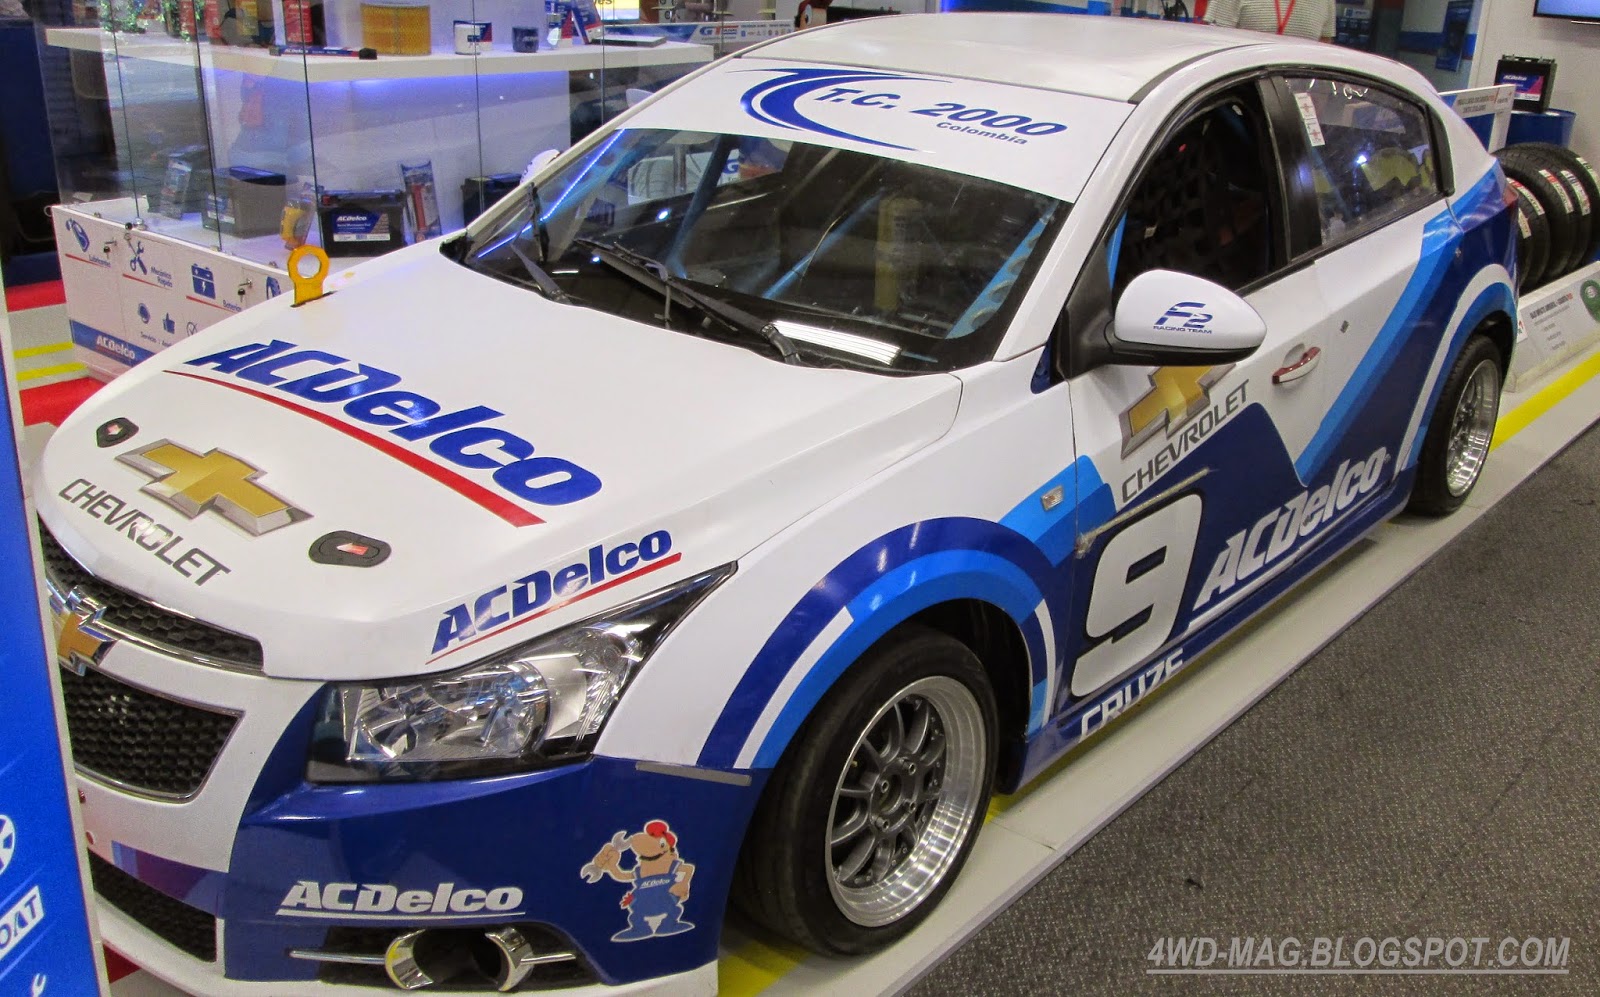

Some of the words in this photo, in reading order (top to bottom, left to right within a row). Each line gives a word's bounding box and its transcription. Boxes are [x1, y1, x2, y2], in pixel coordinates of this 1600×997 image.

[814, 87, 901, 109] T.C.
[909, 102, 1068, 136] 2000
[936, 121, 1028, 145] Colombia
[95, 335, 136, 360] ACDelco
[1154, 302, 1213, 328] F2
[183, 339, 603, 507] ACDelco
[1121, 378, 1250, 503] CHEVROLET
[58, 477, 232, 588] CHEVROLET
[1192, 446, 1388, 612] ACDelco
[430, 529, 674, 656] ACDelco
[1070, 494, 1203, 698] 9
[280, 880, 525, 915] ACDelco
[640, 878, 671, 889] ACDelco
